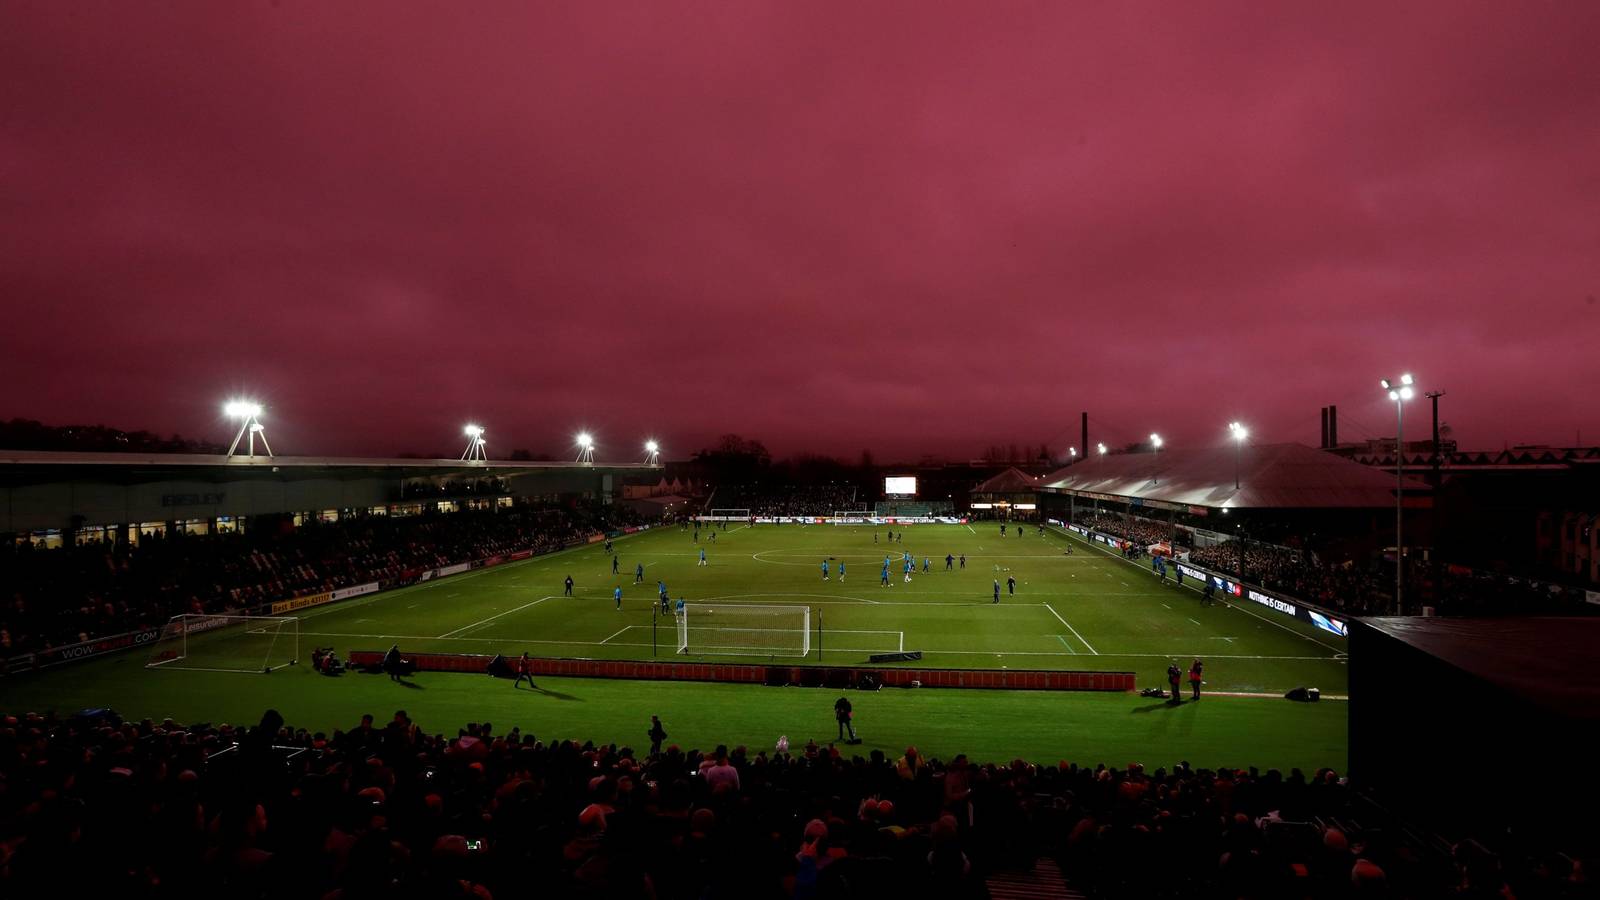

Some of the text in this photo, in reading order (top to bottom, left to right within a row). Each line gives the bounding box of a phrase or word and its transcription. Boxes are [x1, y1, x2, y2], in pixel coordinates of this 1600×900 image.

[290, 598, 310, 609] Blinds
[1248, 590, 1269, 606] NOTHING
[1269, 597, 1274, 608] IS
[1274, 599, 1296, 616] CERTAIN
